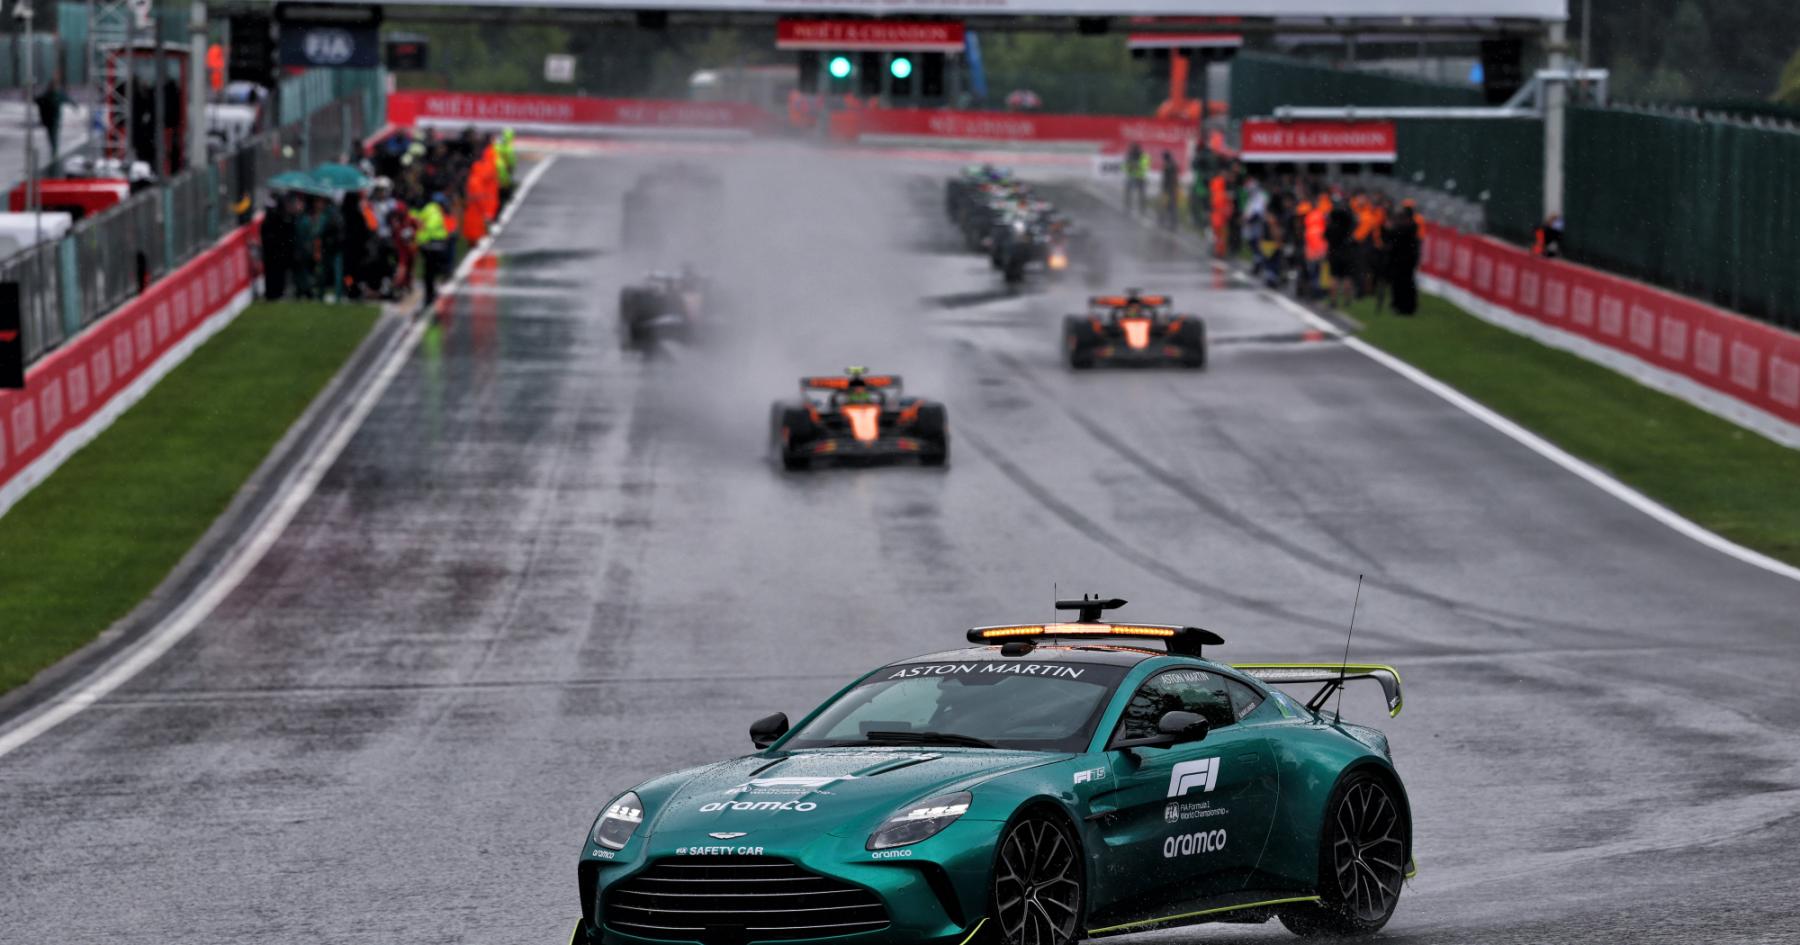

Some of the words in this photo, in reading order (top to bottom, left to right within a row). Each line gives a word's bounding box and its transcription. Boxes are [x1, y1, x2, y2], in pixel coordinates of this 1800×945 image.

[304, 33, 351, 57] FIA
[888, 664, 978, 679] ASTON
[980, 664, 1085, 678] MARTIN
[1161, 674, 1183, 684] ASTON
[1183, 672, 1209, 681] MARTIN
[1167, 756, 1221, 798] F1
[699, 800, 817, 812] aramco
[1165, 804, 1178, 821] FIA
[1164, 829, 1227, 858] aramco
[592, 850, 615, 859] aramco
[689, 846, 735, 856] SAFETY
[737, 846, 764, 856] CAR
[872, 849, 912, 859] aramco
